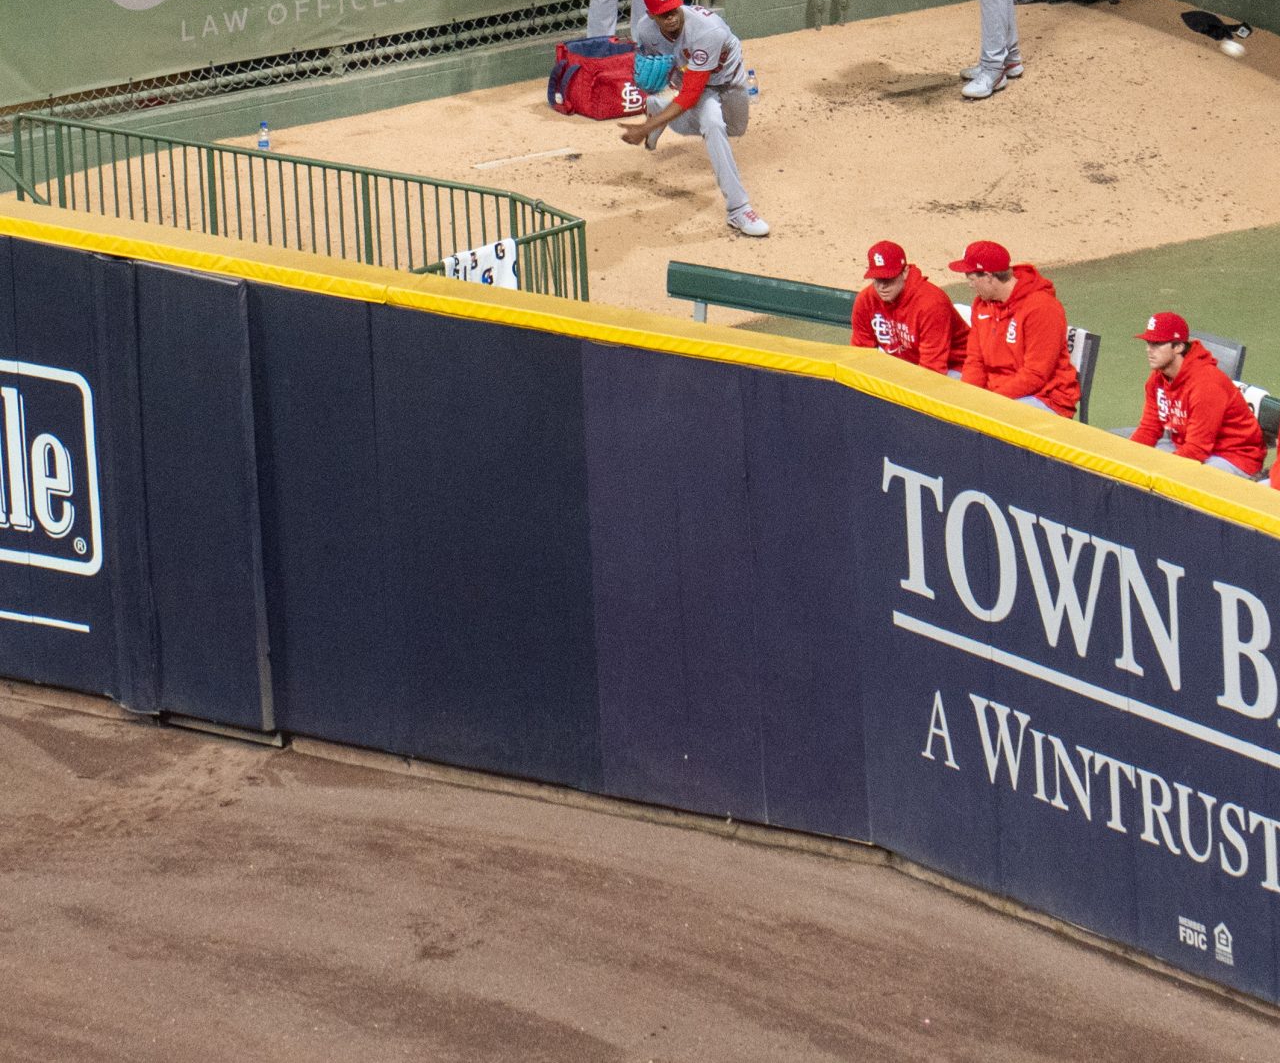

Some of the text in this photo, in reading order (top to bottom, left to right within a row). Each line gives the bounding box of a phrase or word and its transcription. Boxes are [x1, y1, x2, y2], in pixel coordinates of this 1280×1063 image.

[180, 10, 250, 42] LAW
[0, 387, 75, 538] le
[882, 456, 1185, 692] TOWN
[921, 690, 960, 771] A
[1179, 925, 1208, 952] FDIC
